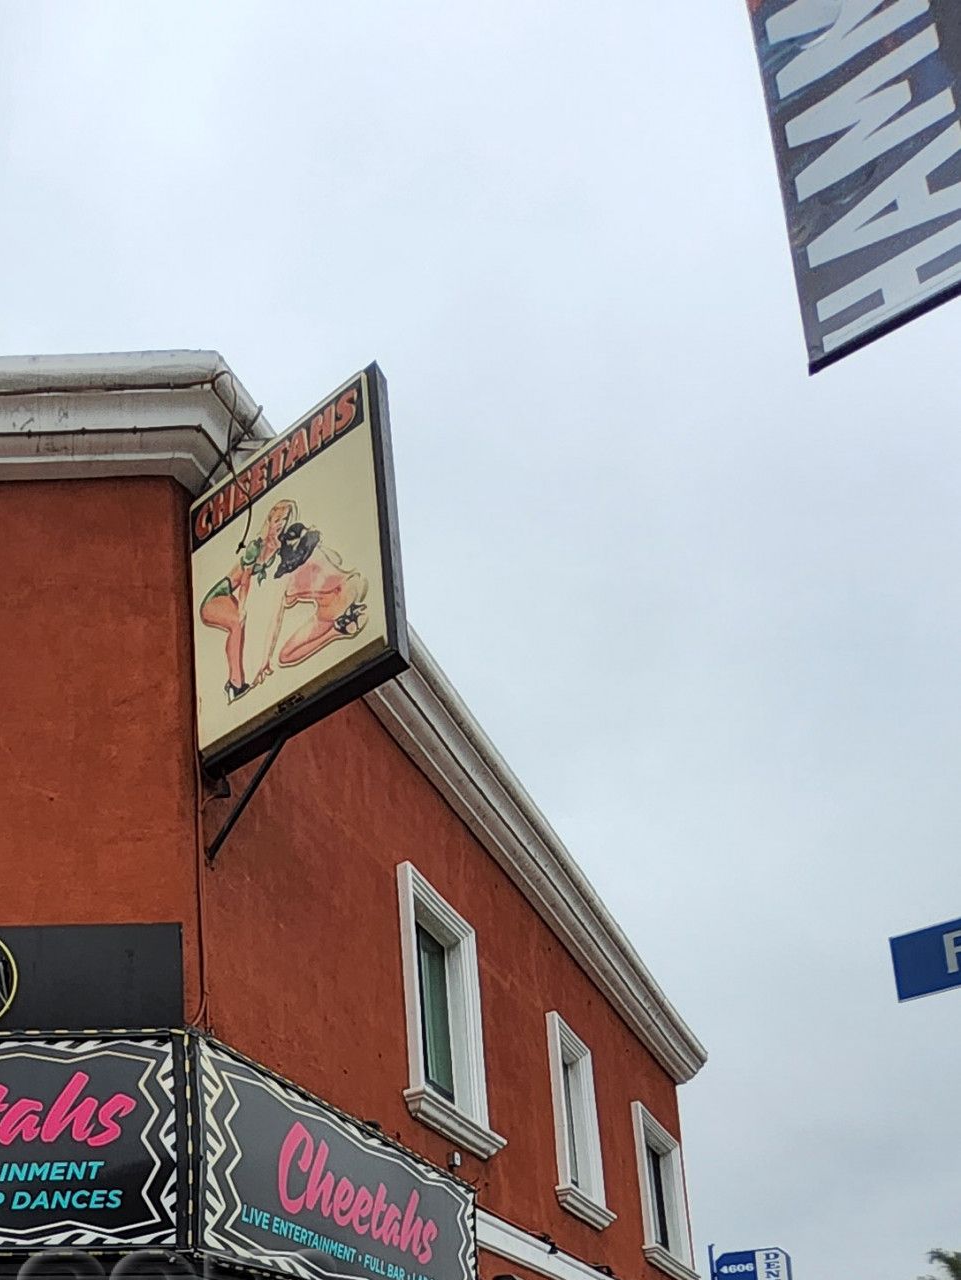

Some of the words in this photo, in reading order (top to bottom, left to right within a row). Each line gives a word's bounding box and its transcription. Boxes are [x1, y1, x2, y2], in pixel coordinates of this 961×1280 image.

[195, 388, 357, 540] CHEETAHS
[11, 1189, 123, 1210] DANCES
[278, 1121, 437, 1264] Cheetahs
[241, 1204, 270, 1230] LIVE
[271, 1217, 356, 1264] ENTERTAINMENT
[363, 1254, 386, 1275] FULL
[719, 1262, 755, 1274] 4606
